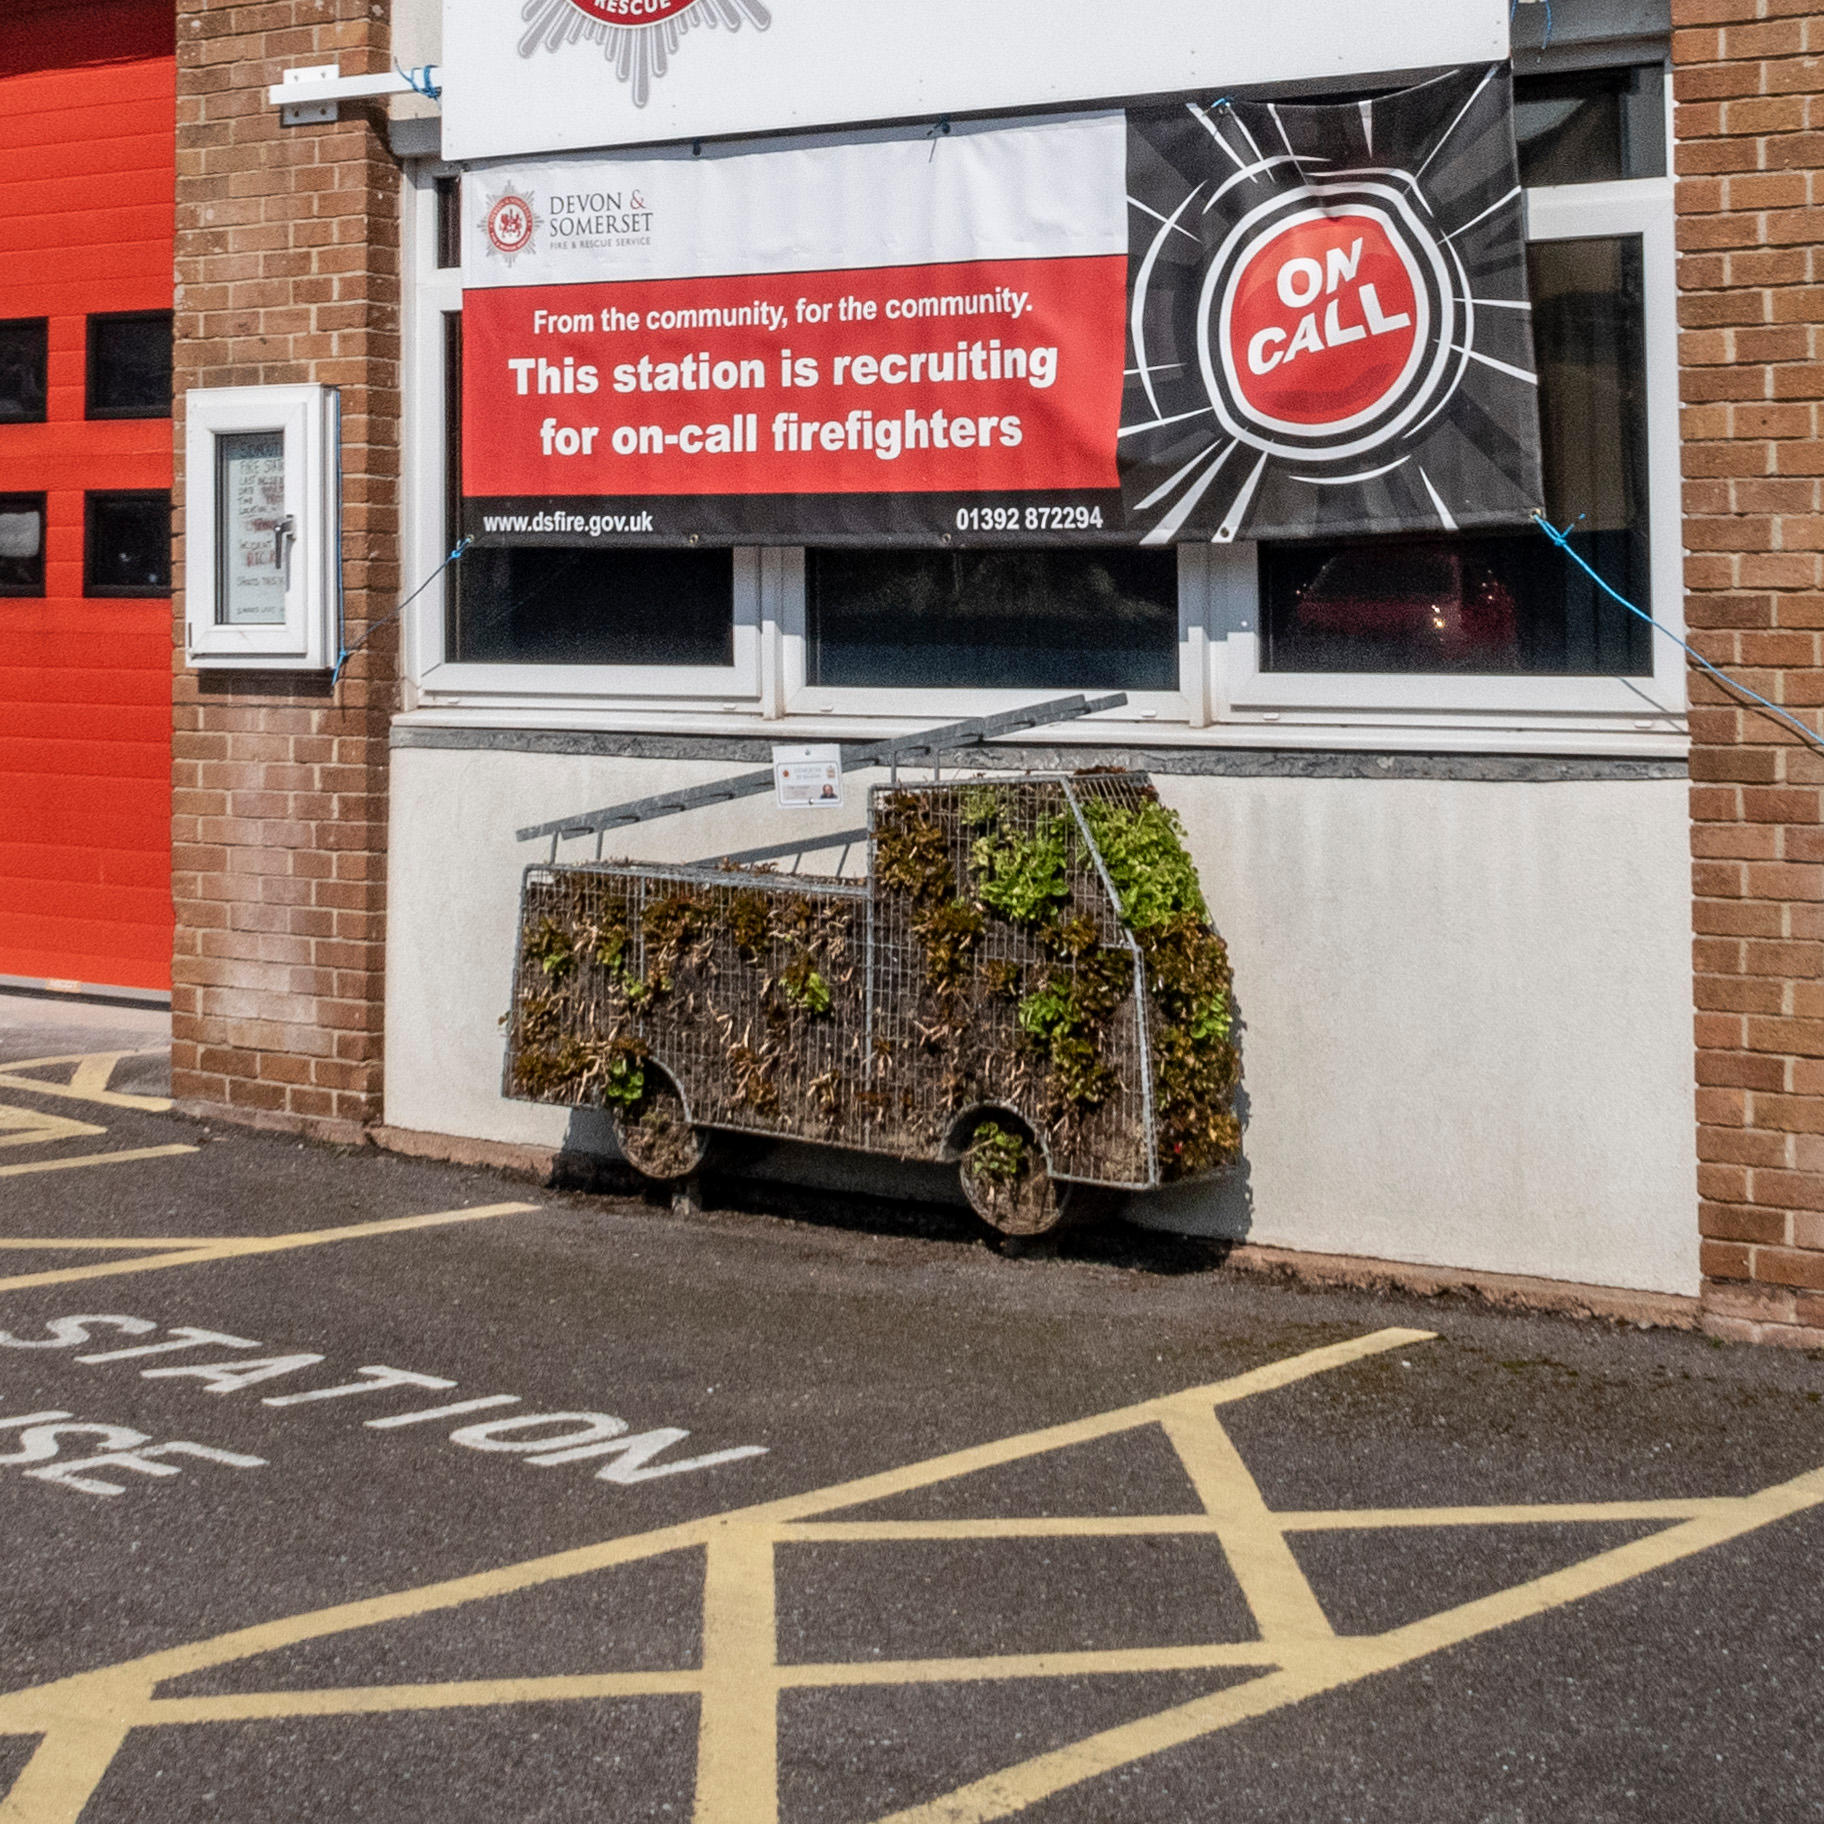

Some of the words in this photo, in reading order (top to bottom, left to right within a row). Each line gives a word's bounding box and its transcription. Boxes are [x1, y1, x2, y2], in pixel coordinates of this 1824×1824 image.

[550, 192, 622, 215] DEVON
[630, 189, 646, 209] &
[550, 213, 653, 237] SOMERSET
[550, 241, 567, 249] FIRE
[580, 238, 612, 248] RESCUE
[616, 237, 650, 247] SERVICE
[1277, 237, 1363, 308] ON
[533, 309, 594, 334] From
[600, 306, 640, 331] the
[646, 300, 788, 331] community,
[795, 298, 831, 325] for
[839, 295, 877, 322] the
[884, 287, 1033, 323] community.
[1248, 283, 1411, 375] CALL
[509, 357, 599, 395] This
[613, 352, 765, 392] station
[780, 349, 818, 387] is
[833, 339, 1058, 389] recruiting
[540, 418, 599, 456] for
[612, 414, 757, 455] on-call
[772, 409, 1023, 460] firefighters
[483, 512, 654, 536] www.dsfire.gov.uk
[955, 507, 1021, 532] 01392
[1024, 505, 1104, 531] 872294
